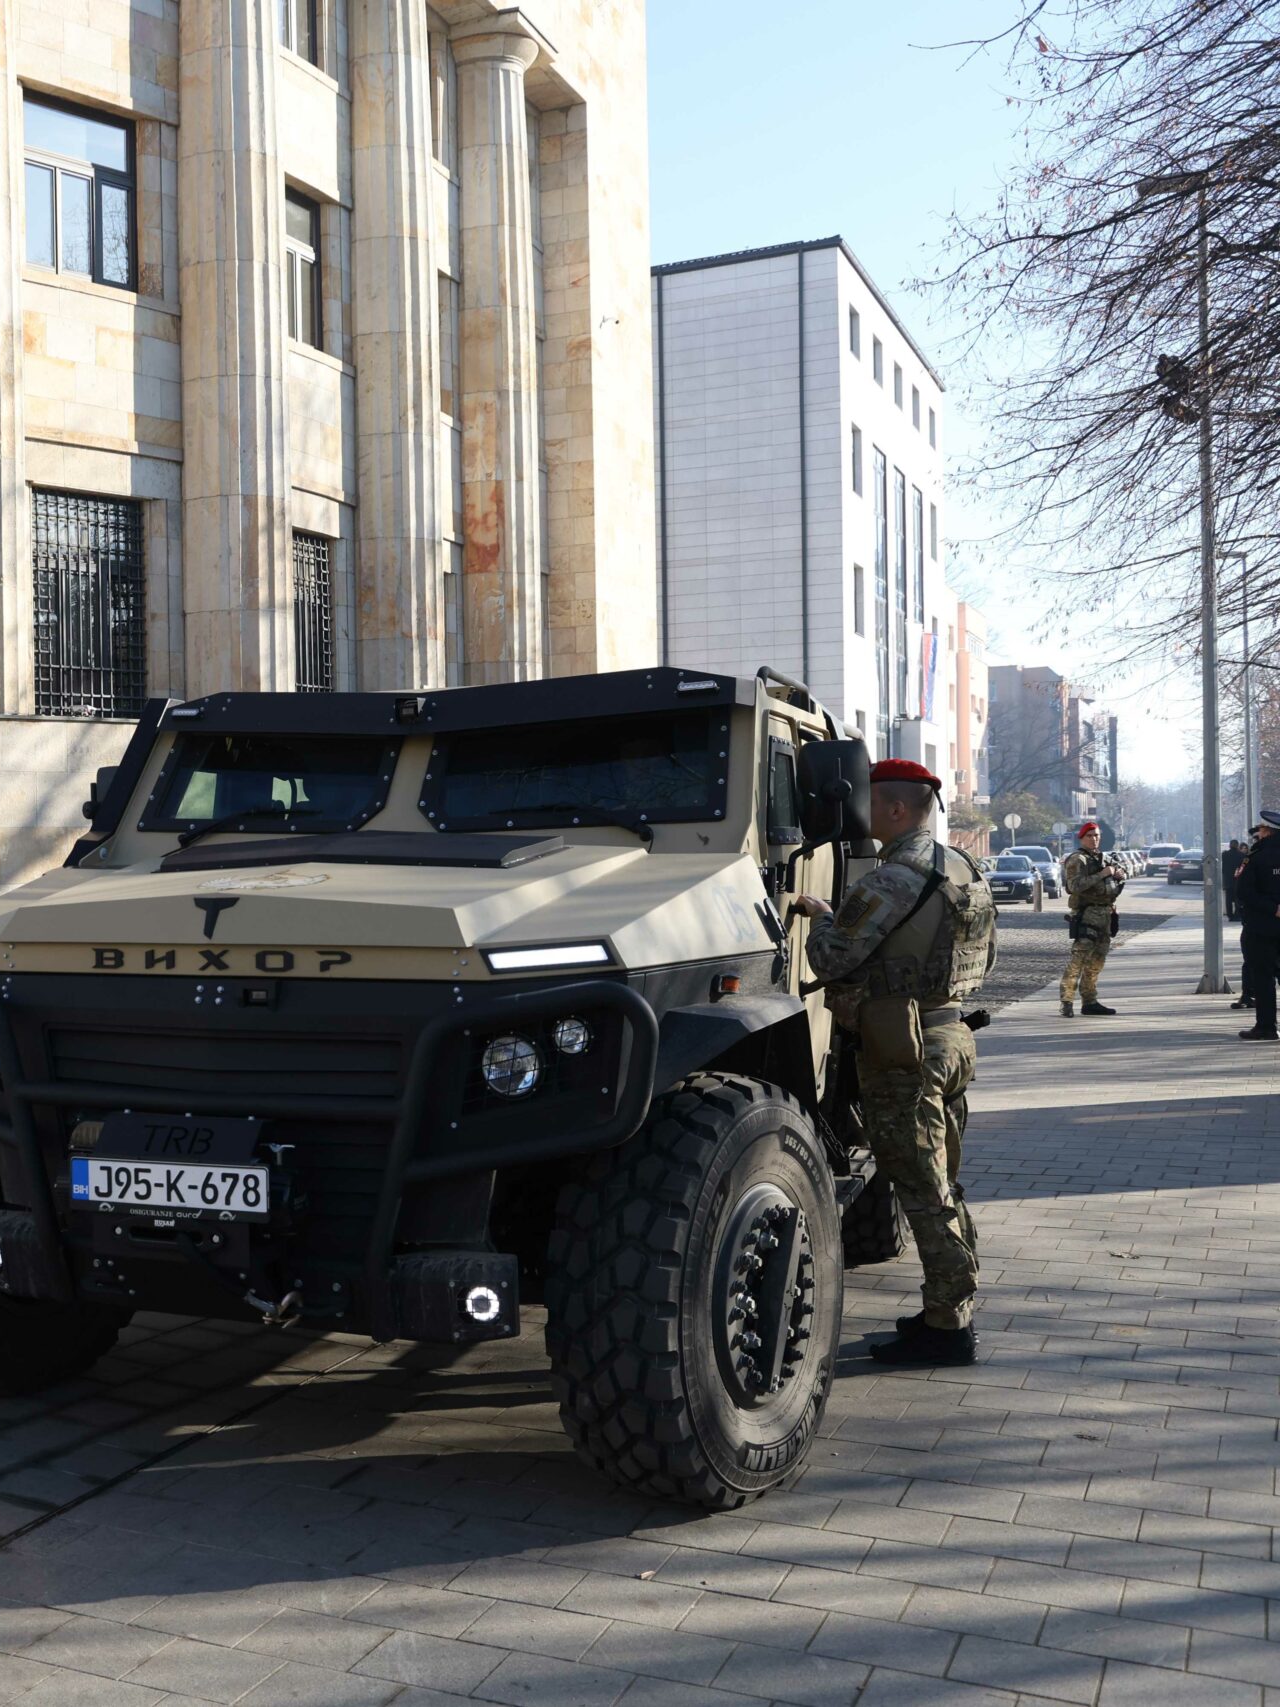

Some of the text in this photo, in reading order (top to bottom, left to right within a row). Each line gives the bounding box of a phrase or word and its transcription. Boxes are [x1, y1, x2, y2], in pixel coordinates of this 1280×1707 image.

[92, 948, 352, 972] ВИХОР
[144, 1124, 215, 1155] TRB
[785, 1134, 809, 1161] 365/80
[73, 1184, 89, 1194] BIH
[94, 1165, 261, 1207] J95-K-678
[129, 1208, 174, 1217] OSIGURANJE
[744, 1399, 816, 1471] MICHELIN
